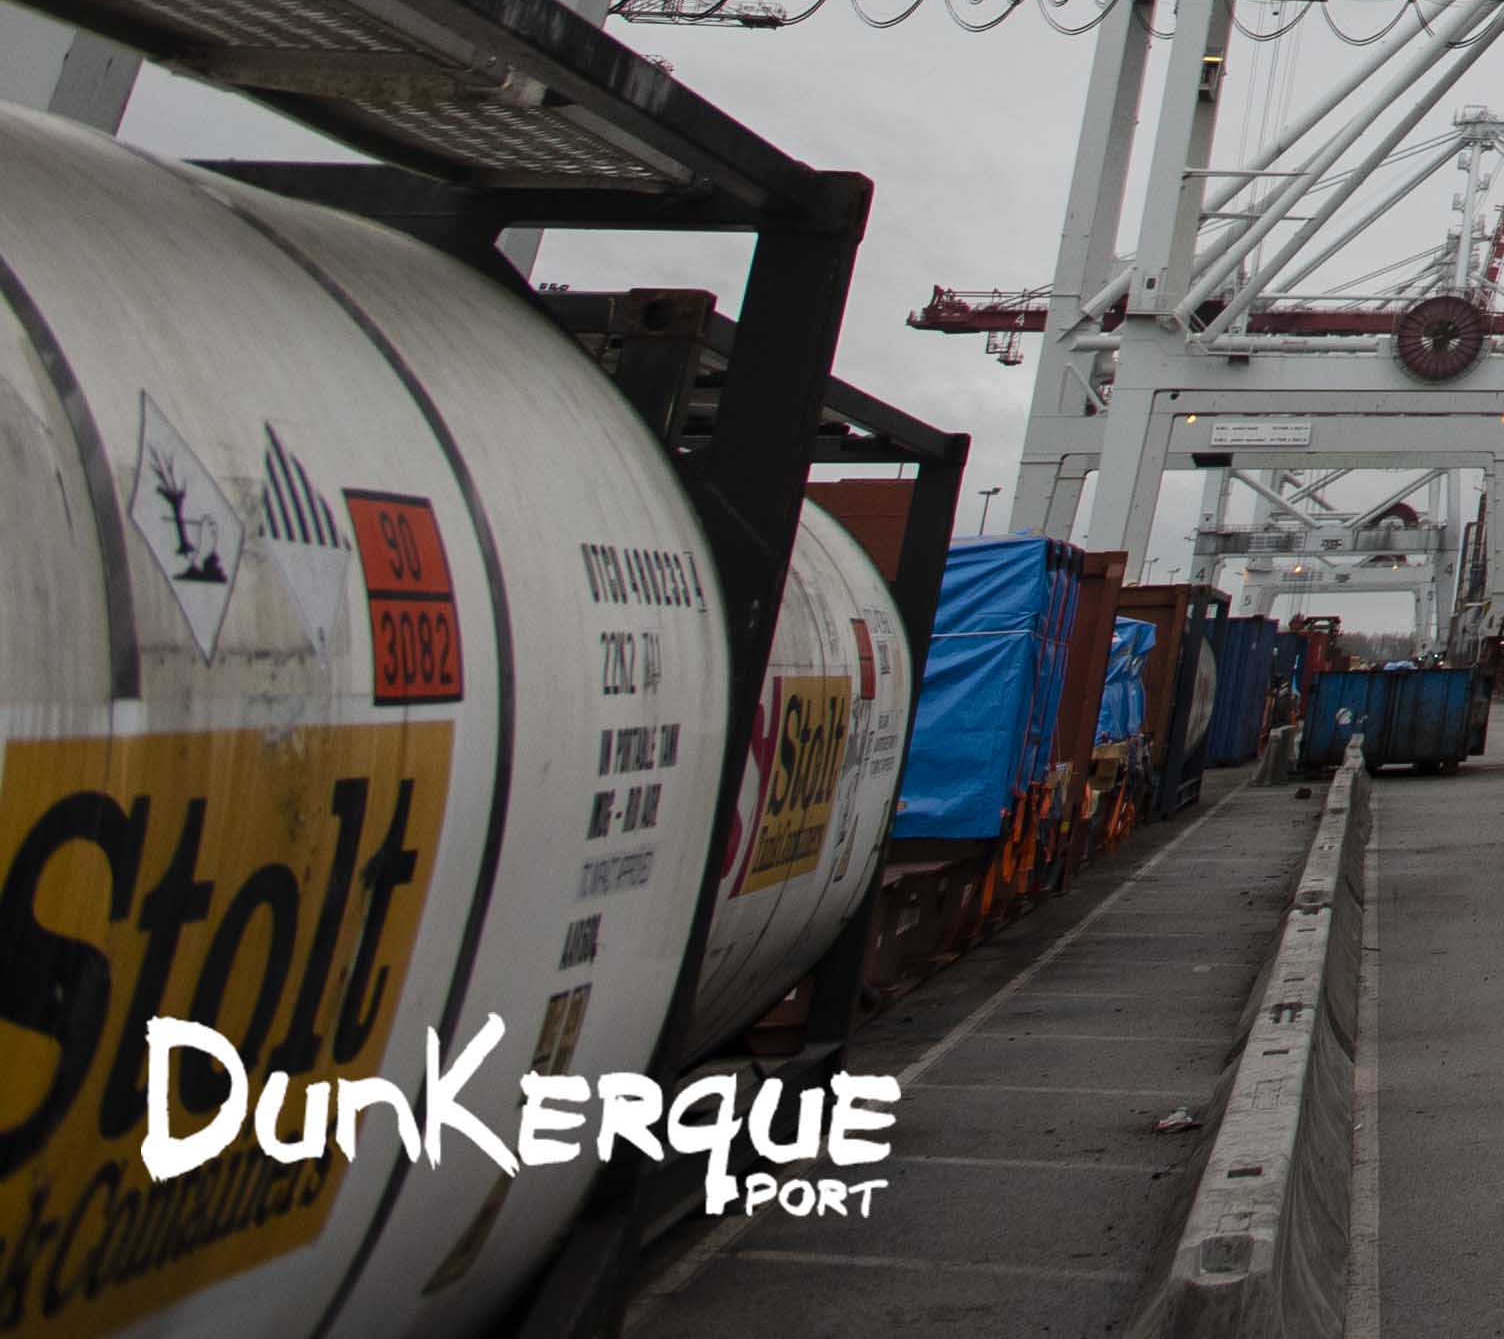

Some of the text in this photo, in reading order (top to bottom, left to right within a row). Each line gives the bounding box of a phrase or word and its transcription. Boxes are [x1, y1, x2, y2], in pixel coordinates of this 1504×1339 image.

[379, 510, 422, 581] 90
[381, 610, 453, 686] 3082
[768, 695, 847, 816] Stolt
[0, 778, 419, 1185] Stolt
